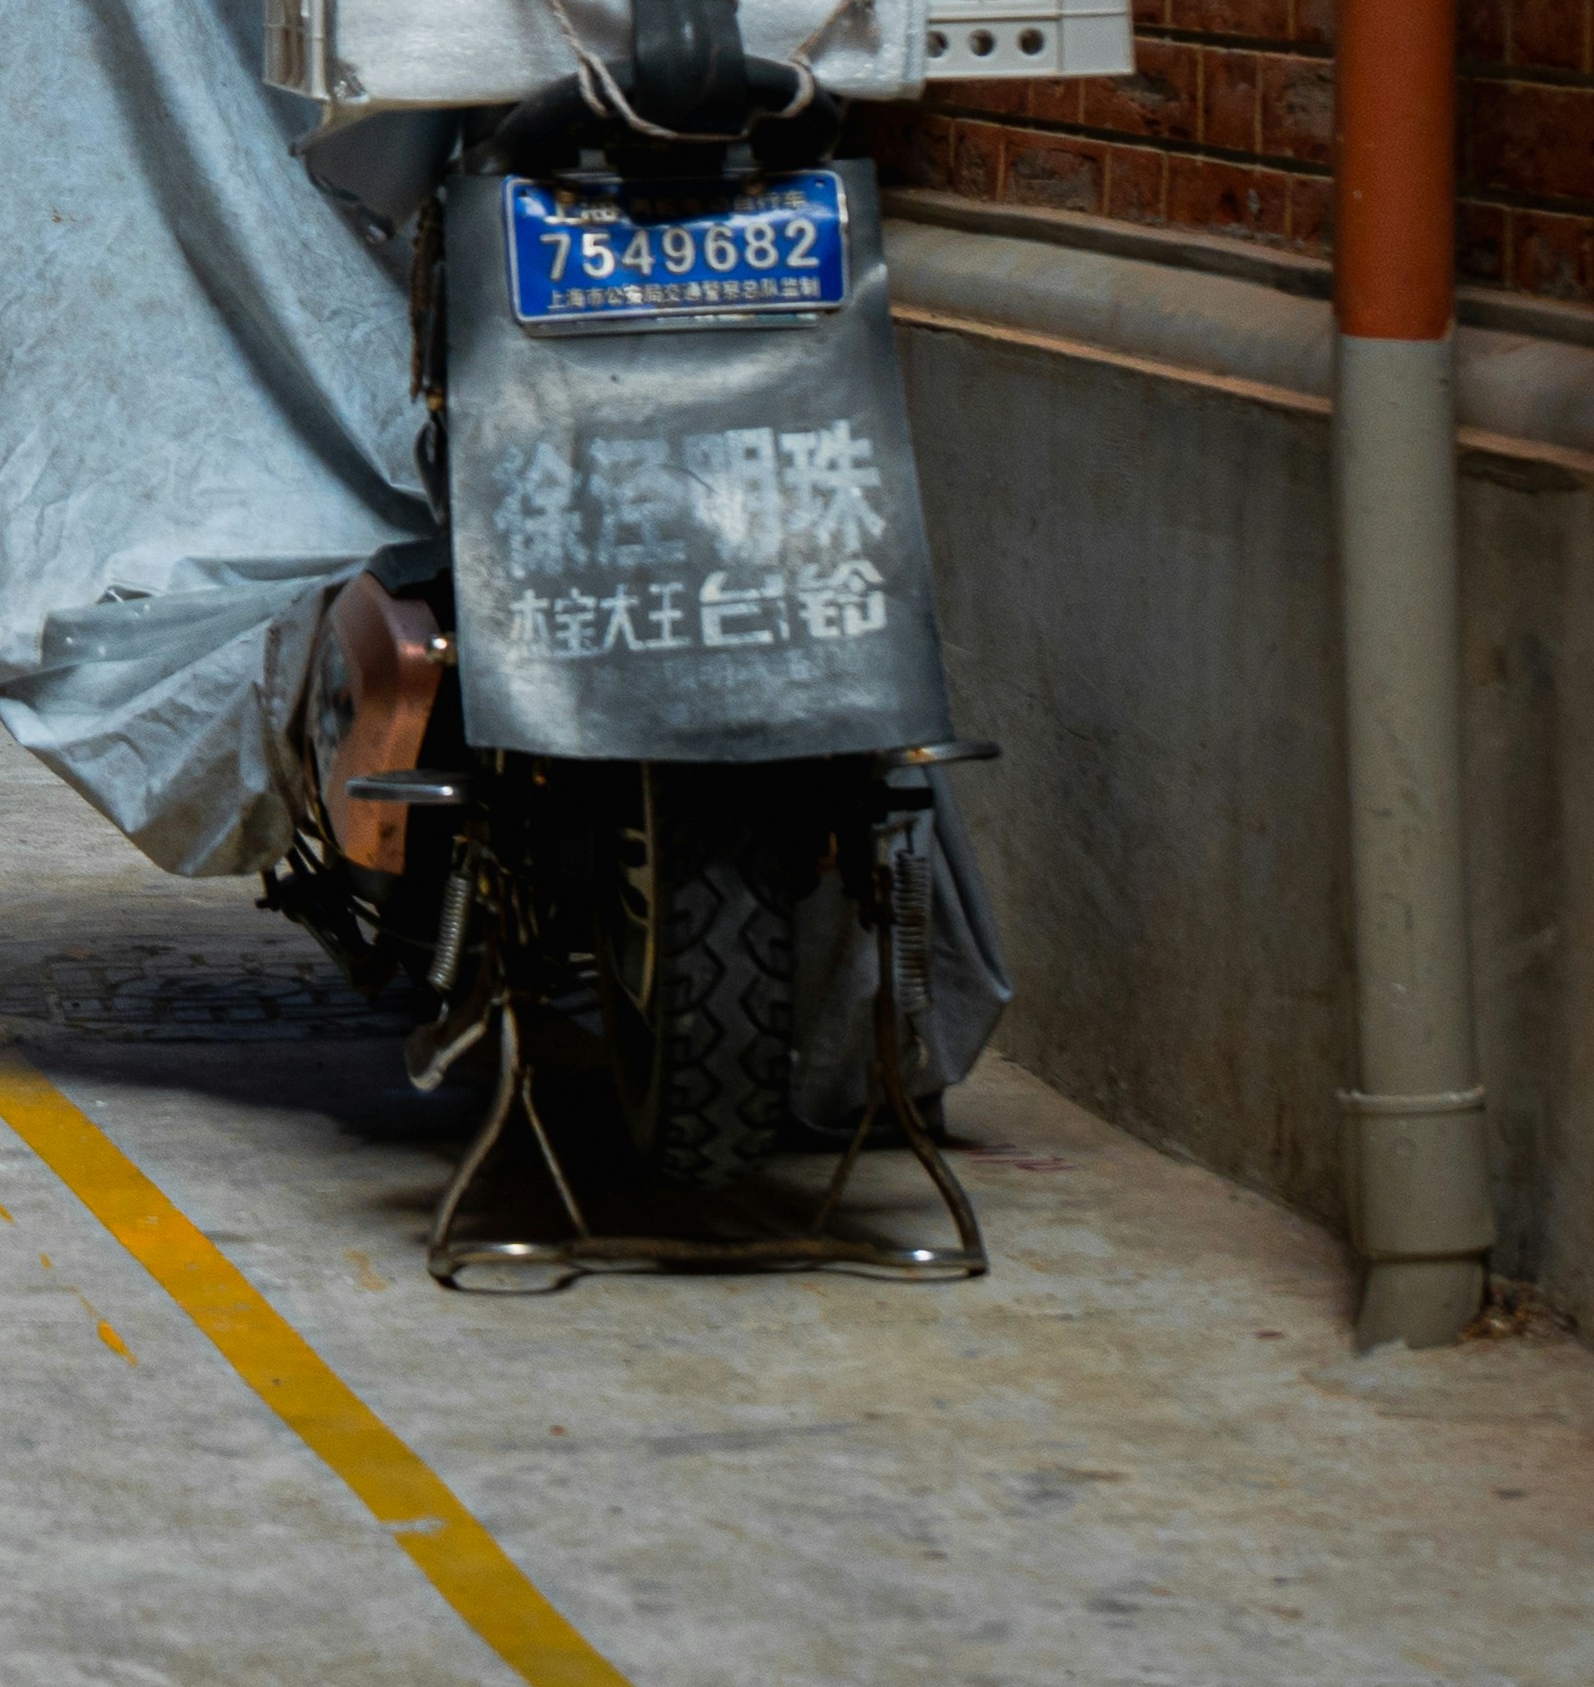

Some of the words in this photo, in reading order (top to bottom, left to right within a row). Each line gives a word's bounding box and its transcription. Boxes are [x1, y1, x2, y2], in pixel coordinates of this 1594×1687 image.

[540, 220, 820, 282] 7549682
[547, 277, 821, 309] 上海市公安局交通警察总队监制
